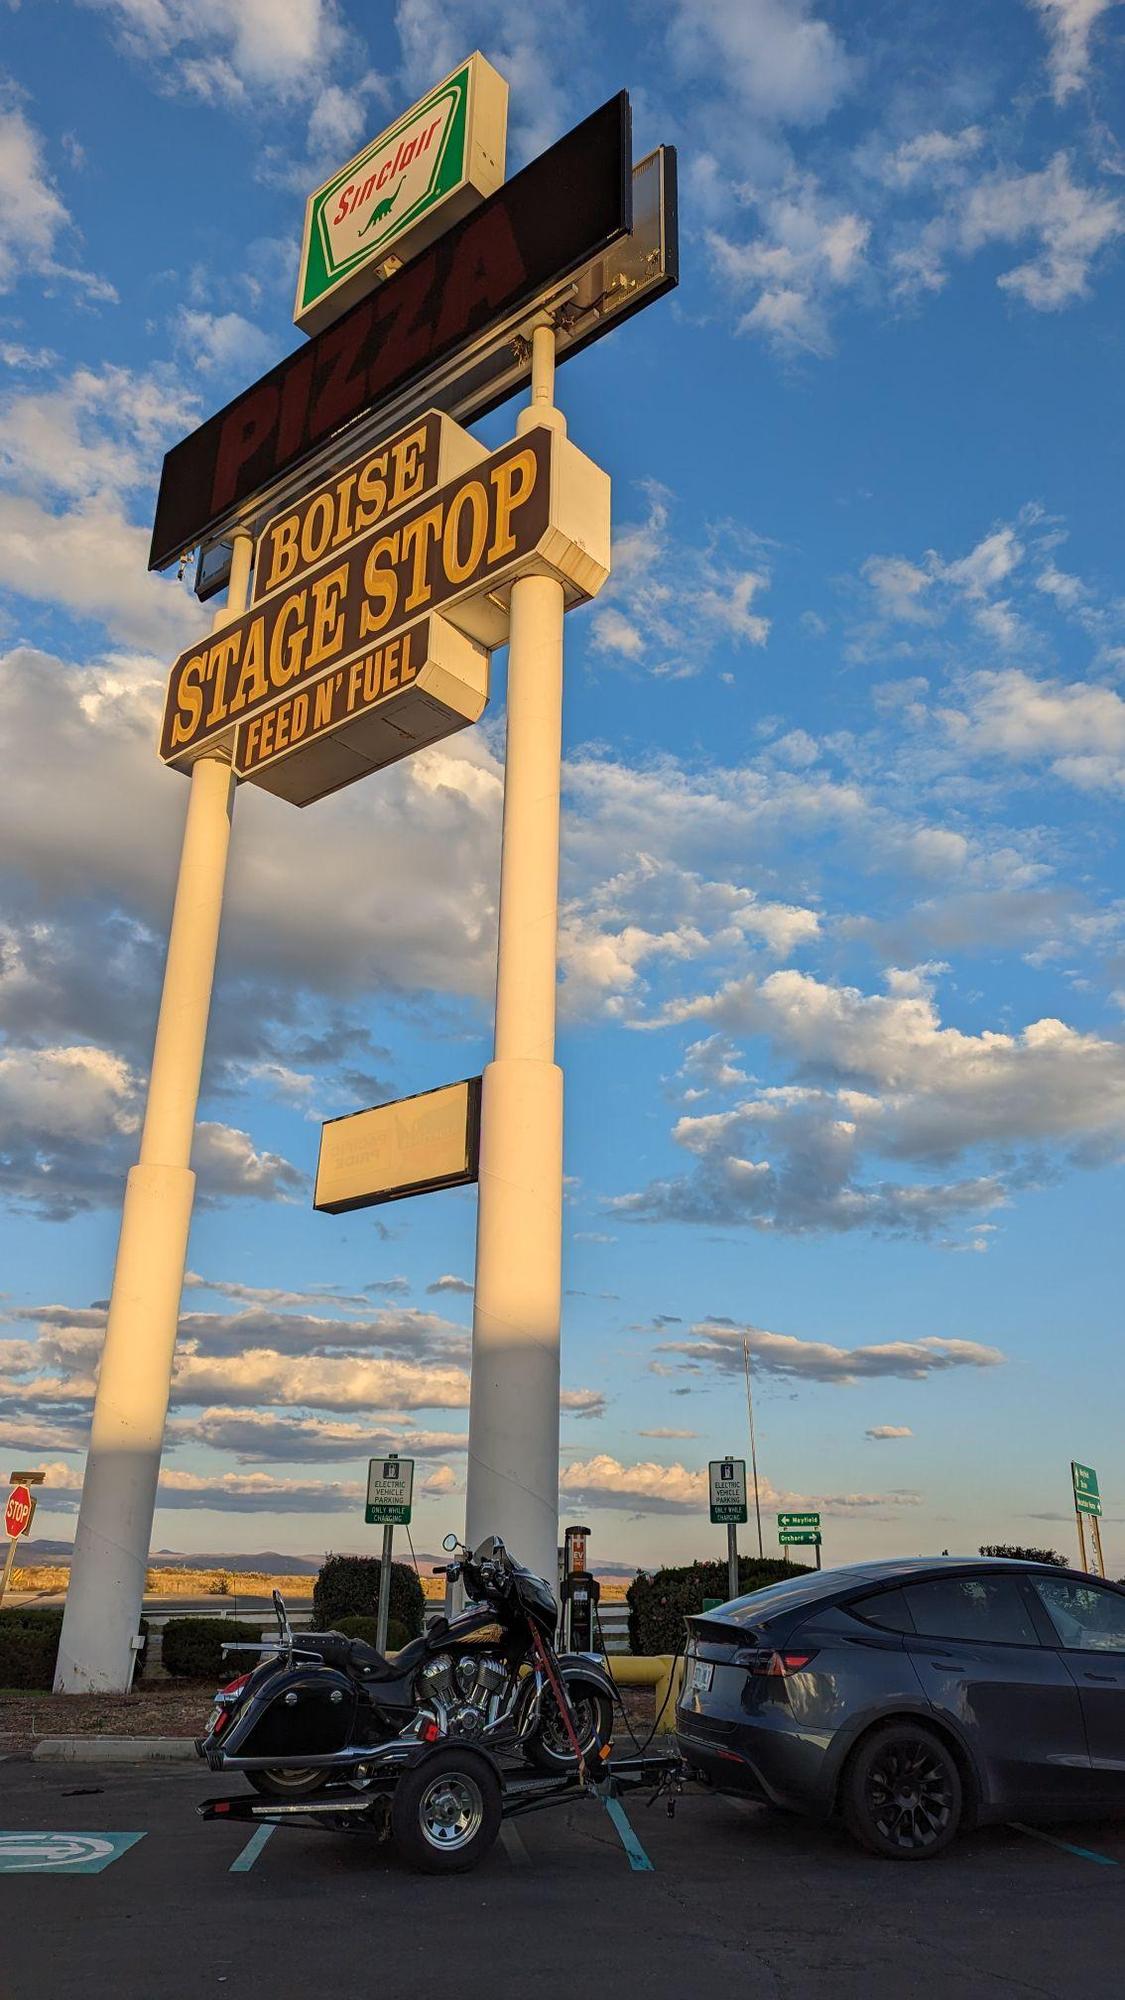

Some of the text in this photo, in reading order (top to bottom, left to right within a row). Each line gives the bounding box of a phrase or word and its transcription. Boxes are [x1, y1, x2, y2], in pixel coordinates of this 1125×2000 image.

[333, 116, 442, 226] Sinclair
[209, 202, 527, 515] PIZZA
[265, 425, 428, 591] BOISE
[170, 448, 539, 749] STAGE STOP
[244, 633, 417, 767] FEED N' FUEL
[374, 1480, 406, 1489] ELECTRIC
[714, 1481, 741, 1489] ELECTRIC
[375, 1488, 404, 1496] VEHICLE
[374, 1496, 404, 1504] PARKING
[715, 1496, 740, 1504] PARKING
[7, 1500, 29, 1523] STOP
[371, 1506, 406, 1515] ONLY WHILE
[714, 1506, 742, 1514] ONLY WHILE
[373, 1514, 403, 1522] CHARGING
[792, 1516, 818, 1525] Mayfield
[573, 1551, 584, 1559] EV
